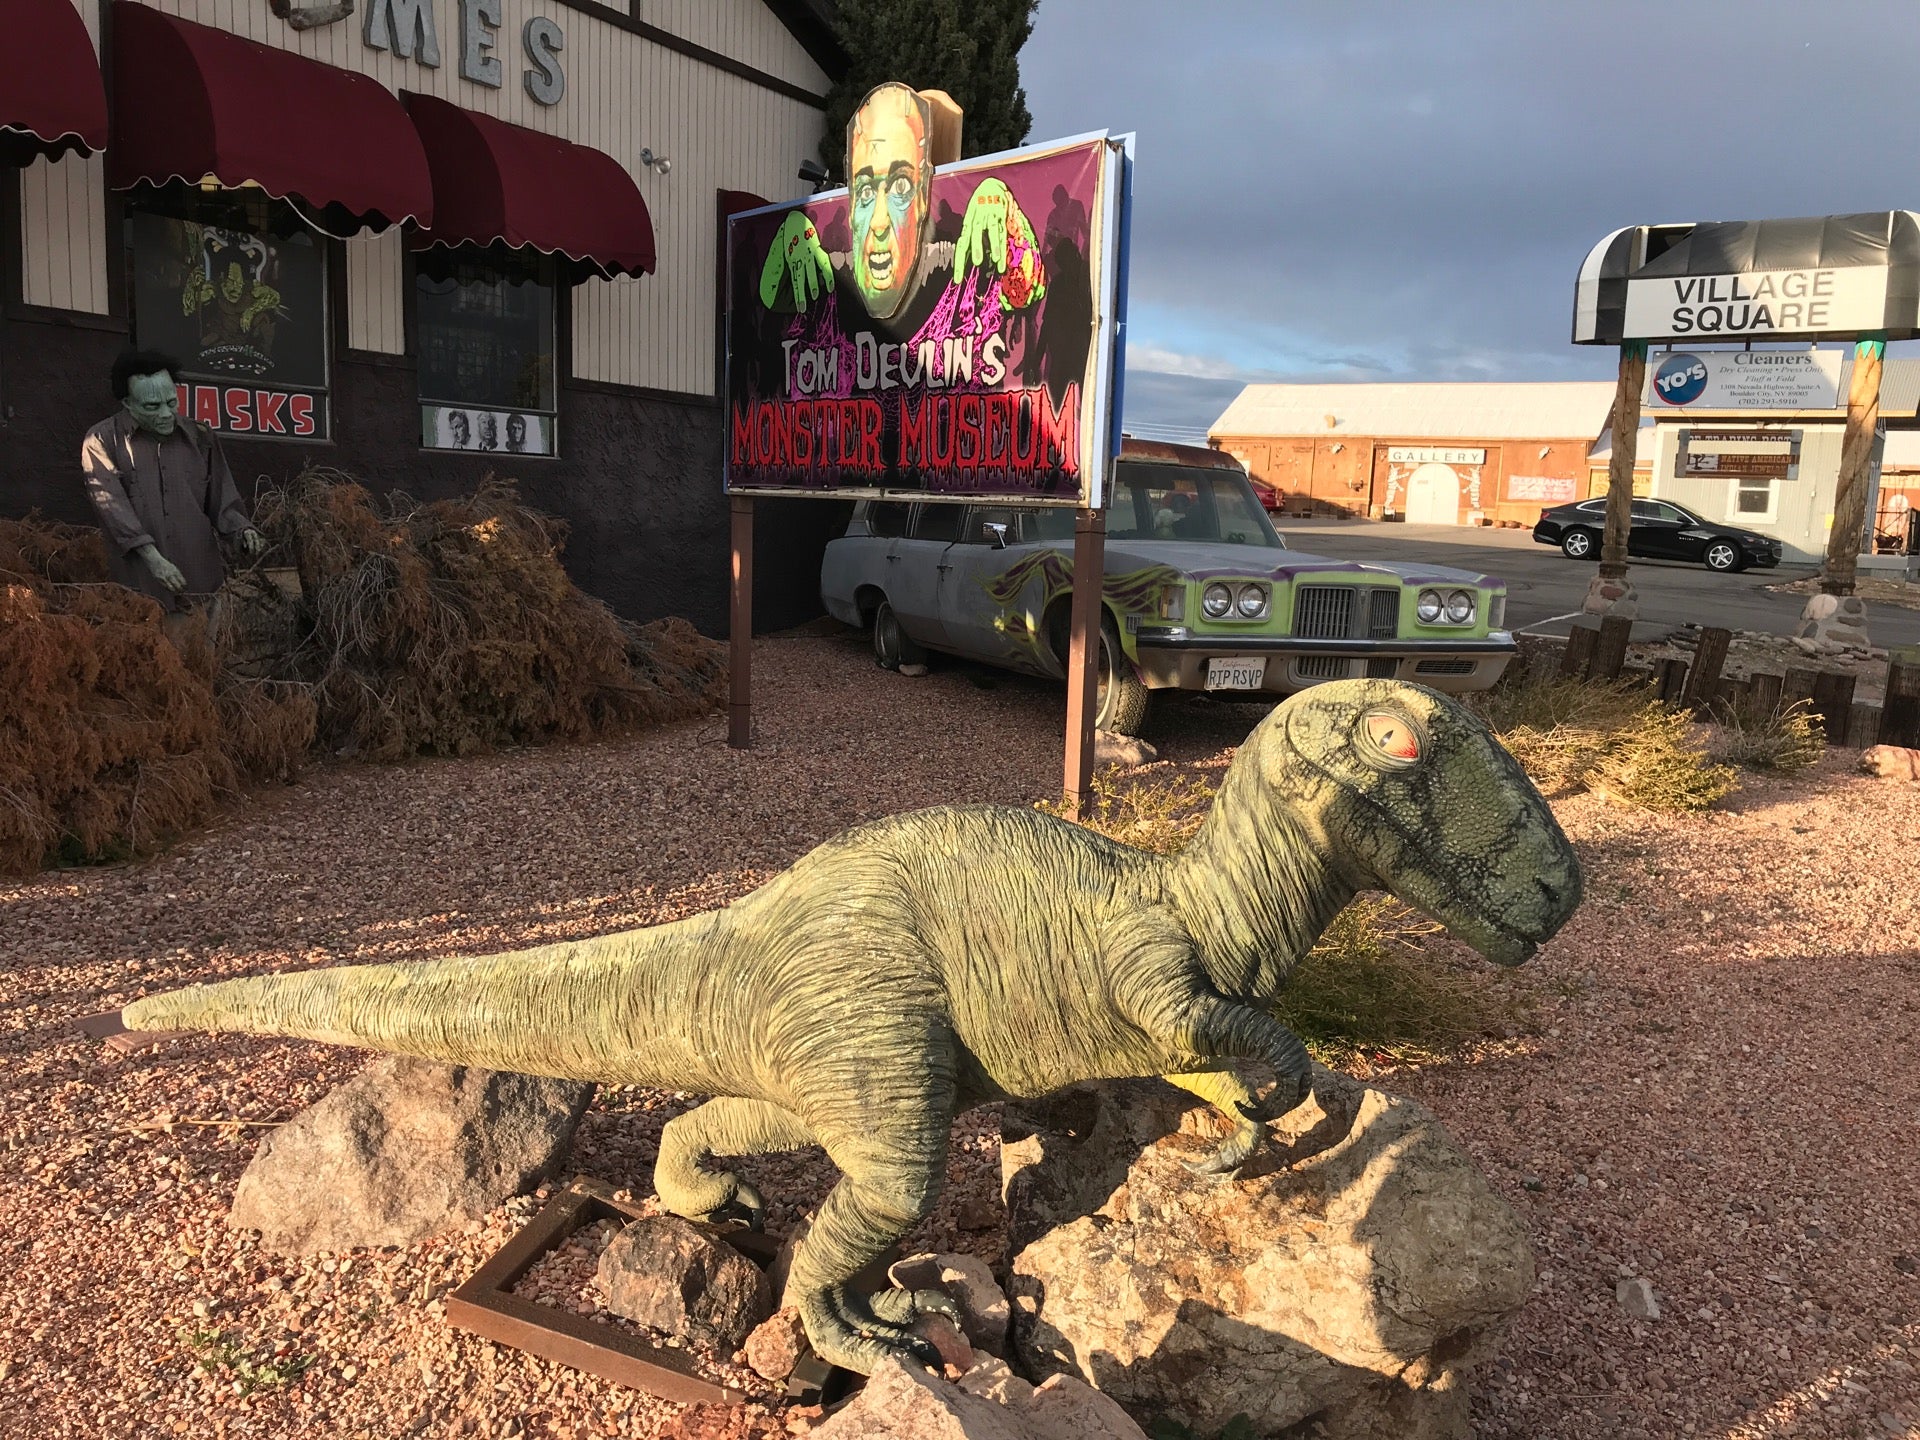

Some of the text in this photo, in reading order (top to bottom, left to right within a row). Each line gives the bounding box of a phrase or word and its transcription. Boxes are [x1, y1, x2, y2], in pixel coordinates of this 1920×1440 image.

[1674, 271, 1835, 304] VILLAGE
[1672, 301, 1829, 333] SQUARE
[781, 316, 1007, 395] TOM DEVLIN'S
[1719, 366, 1735, 374] Dry
[1737, 366, 1773, 374] Cleaning
[1734, 353, 1812, 365] Cleaners
[1656, 363, 1706, 393] YO'S
[731, 382, 1079, 486] MONSTER MUSEUM
[1393, 451, 1479, 461] GALLERY
[1721, 455, 1792, 464] NATIVE AMERICAN
